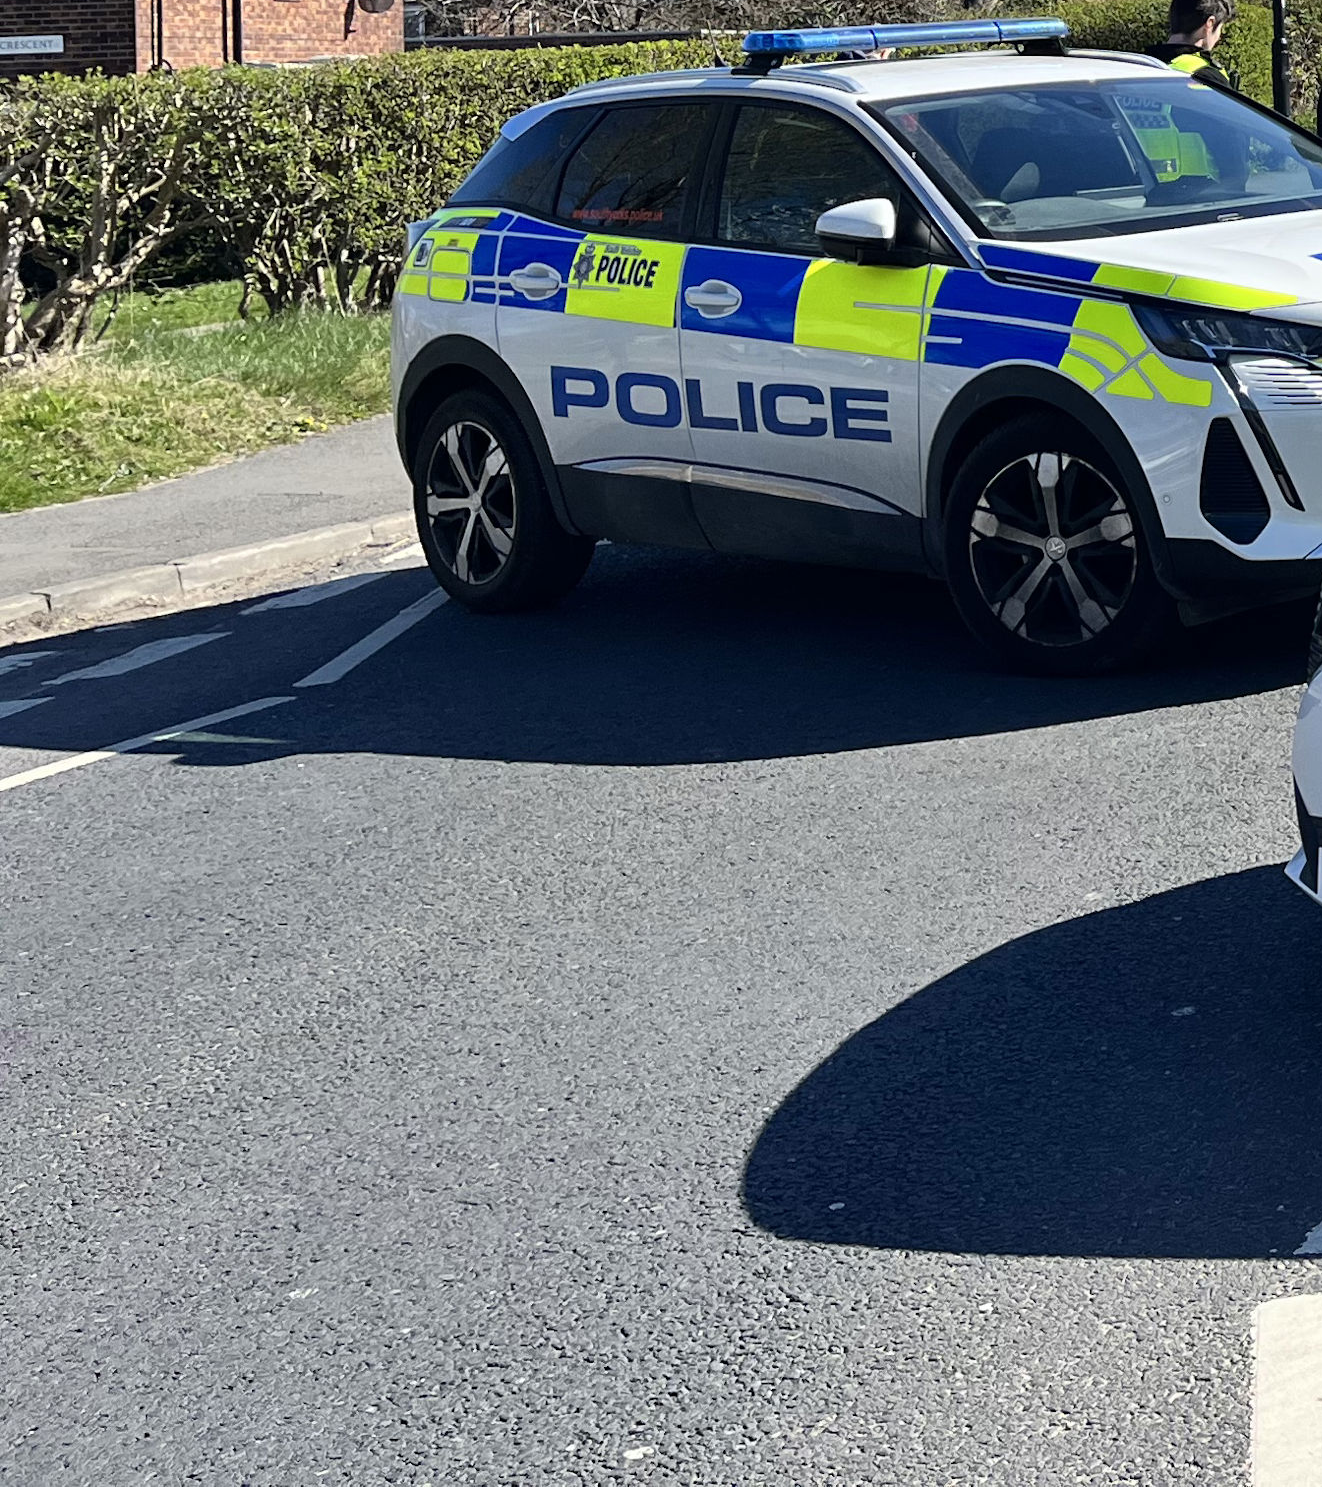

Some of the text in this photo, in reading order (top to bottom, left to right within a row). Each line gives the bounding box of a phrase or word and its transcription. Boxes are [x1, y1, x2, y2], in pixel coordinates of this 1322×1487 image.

[0, 40, 53, 49] CRESCENT
[595, 255, 660, 288] POLICE
[551, 366, 893, 443] POLICE
